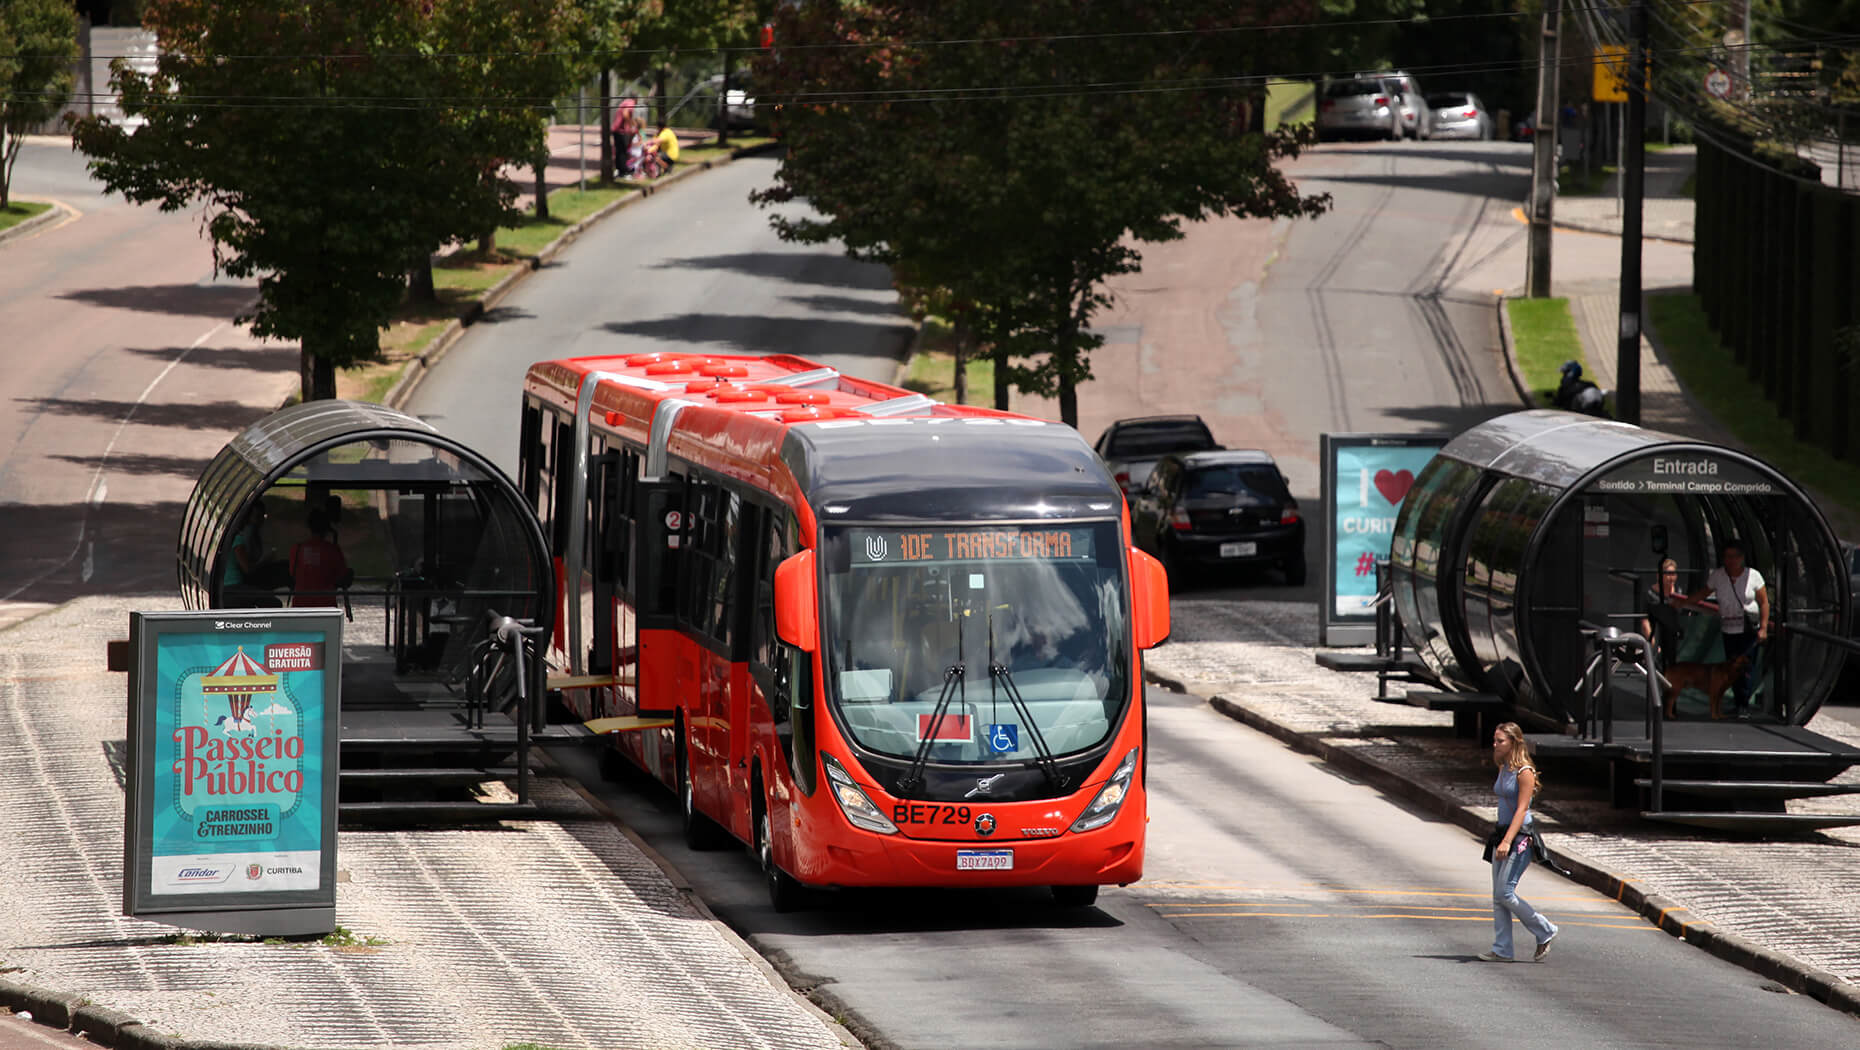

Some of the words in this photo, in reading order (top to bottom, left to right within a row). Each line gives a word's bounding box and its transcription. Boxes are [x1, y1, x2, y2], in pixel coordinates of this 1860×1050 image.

[1653, 458, 1718, 475] Entrada
[1599, 480, 1635, 490] Sentido
[1646, 480, 1685, 491] Terminal
[1687, 481, 1722, 493] Campo
[1723, 482, 1772, 493] Comprido
[944, 531, 1072, 559] TRANSFORMA
[225, 621, 243, 630] Clear
[244, 620, 272, 630] Channel
[268, 646, 312, 658] DIVERSÃO
[268, 658, 311, 668] GRATUITA
[172, 726, 305, 762] Passeio
[172, 757, 304, 796] Público
[206, 808, 270, 822] CARROSSEL
[893, 805, 971, 824] BE729
[267, 867, 303, 875] CURITIBA
